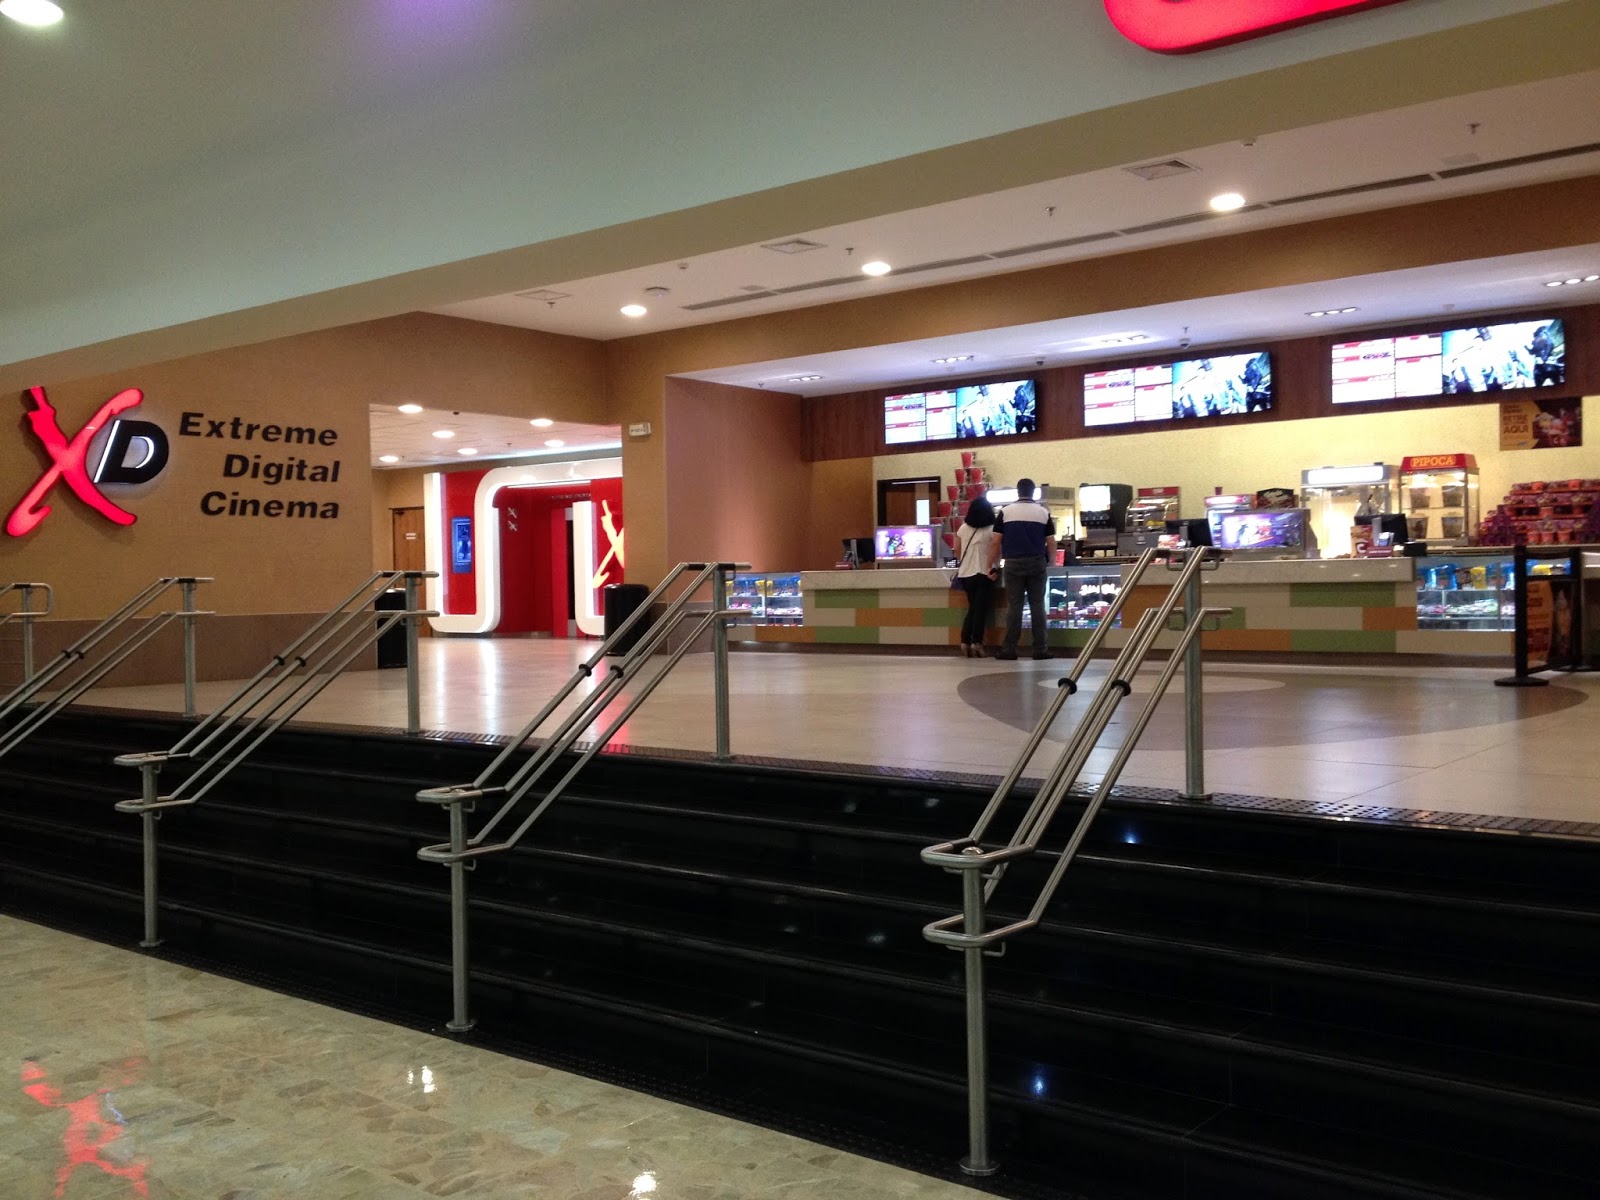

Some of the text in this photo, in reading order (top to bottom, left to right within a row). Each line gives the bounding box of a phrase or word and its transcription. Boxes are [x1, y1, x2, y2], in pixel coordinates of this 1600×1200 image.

[179, 412, 338, 446] Extreme
[1503, 425, 1529, 434] AQUI
[223, 454, 340, 485] Digital
[1412, 456, 1454, 467] PIPOCA
[201, 491, 339, 519] Cinema
